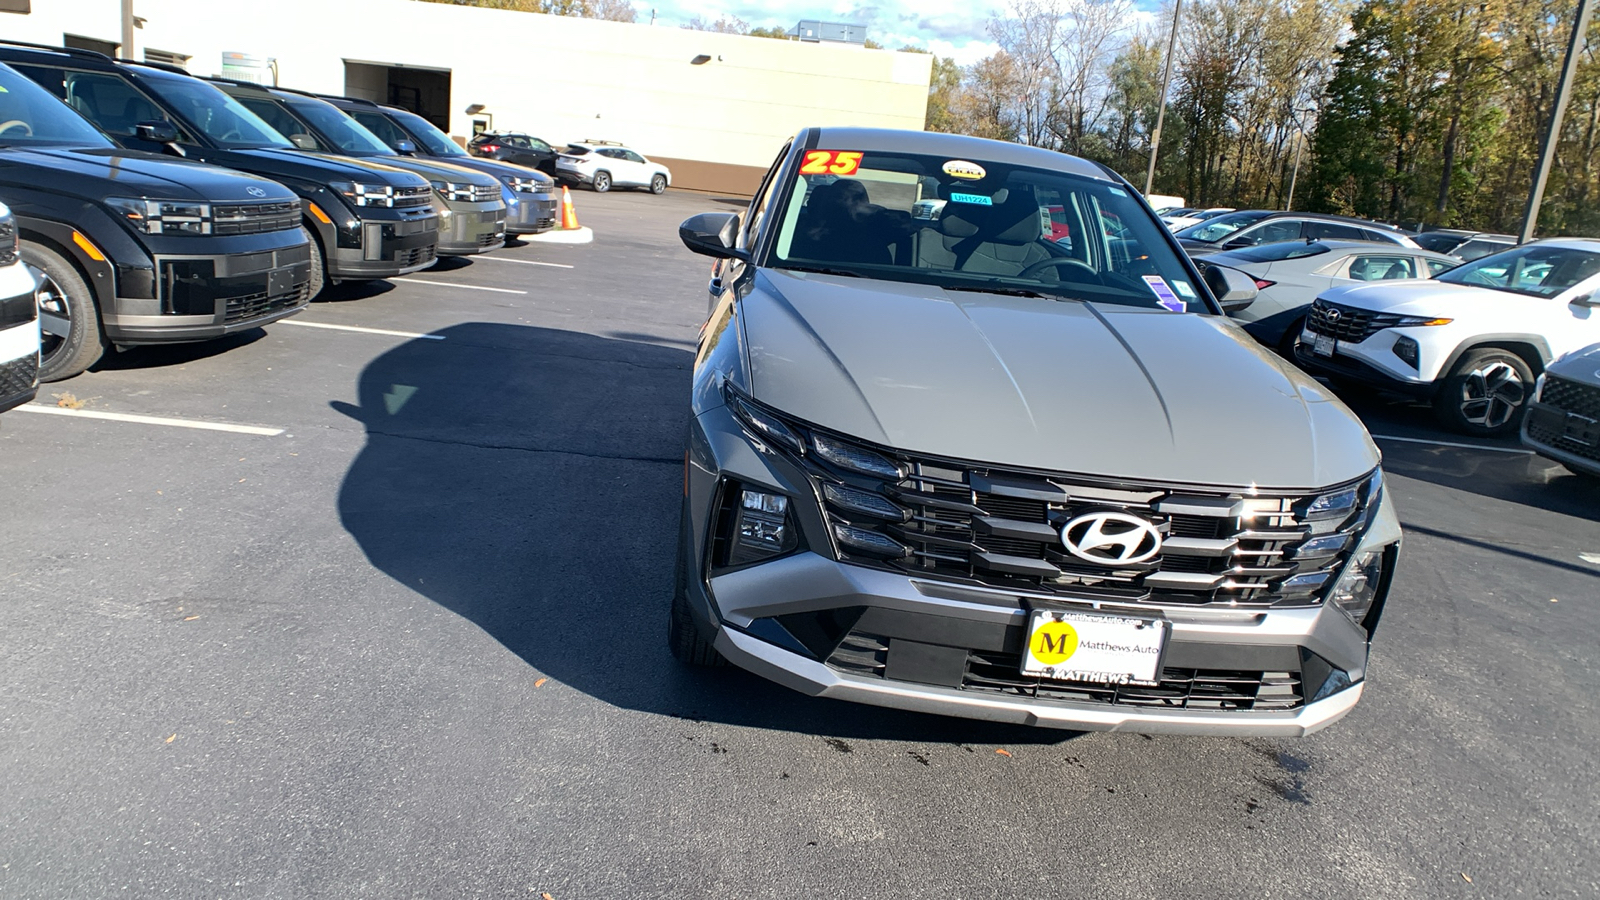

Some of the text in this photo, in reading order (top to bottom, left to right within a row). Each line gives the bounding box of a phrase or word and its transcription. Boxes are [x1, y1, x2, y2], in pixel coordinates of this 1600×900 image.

[801, 152, 861, 174] 25
[954, 194, 988, 204] UH1224
[1037, 632, 1070, 655] M
[1079, 640, 1131, 652] Matthews
[1132, 644, 1159, 654] Auto
[1052, 669, 1129, 684] MATTHEWS
